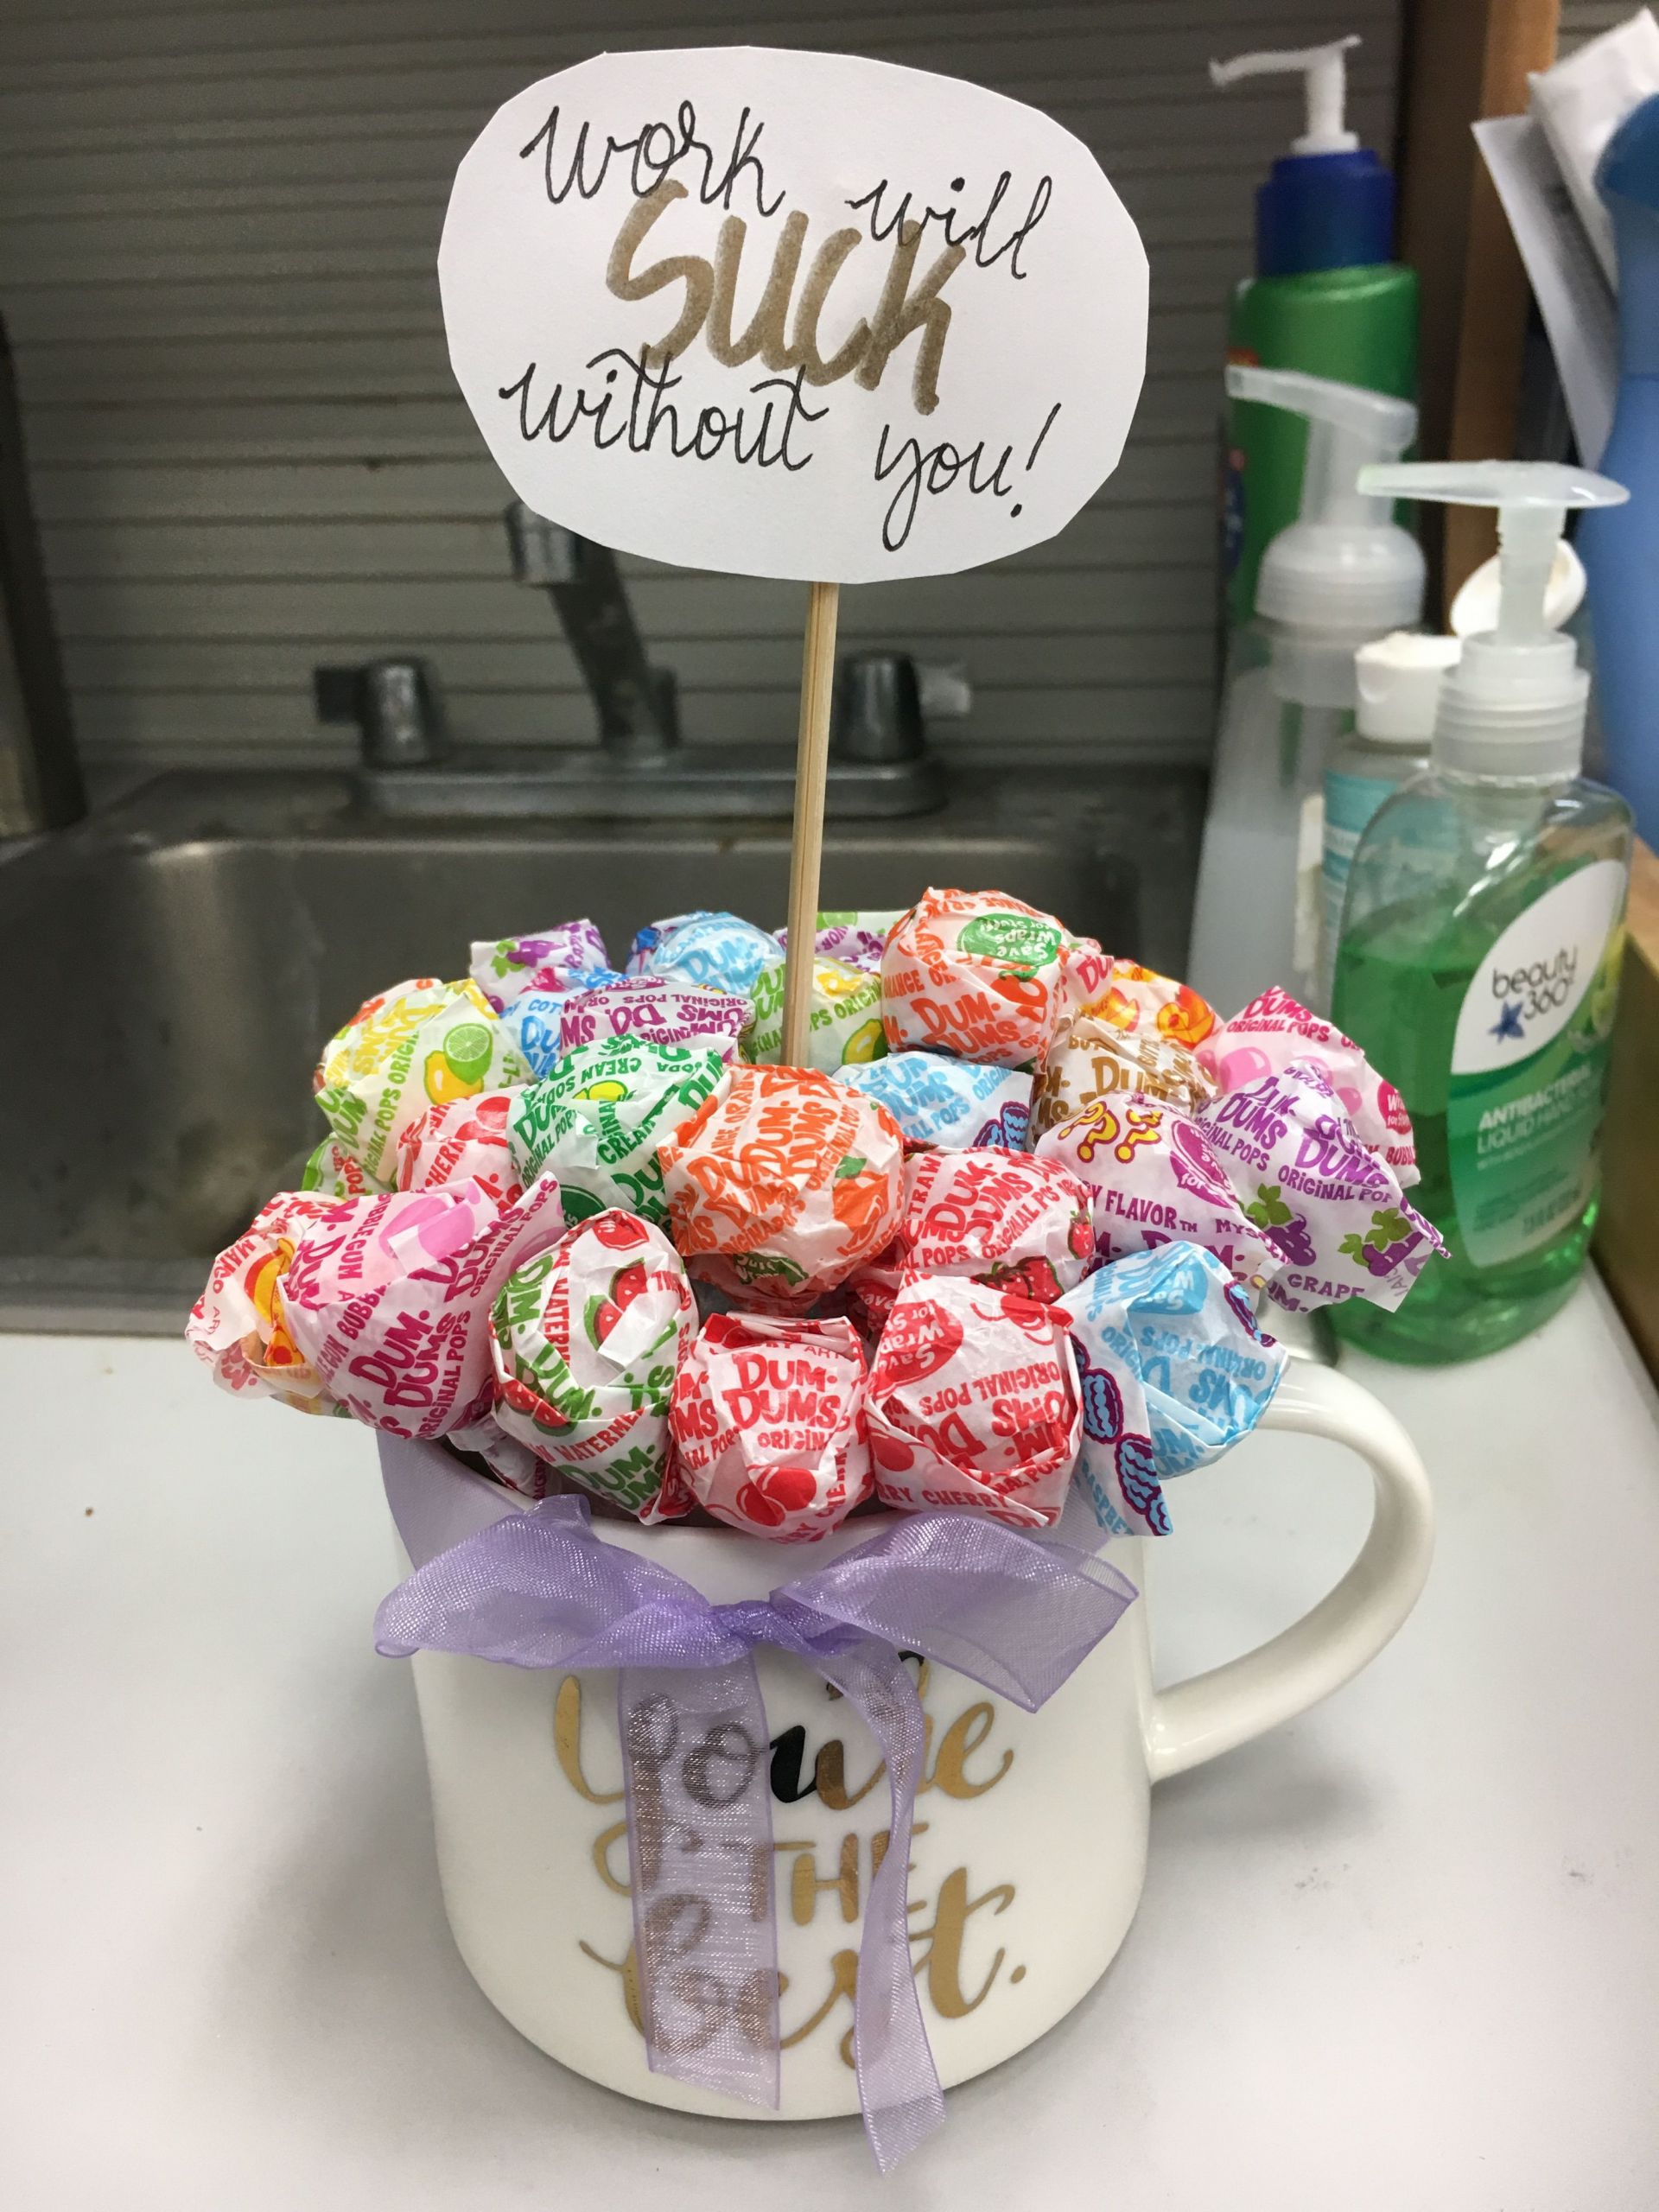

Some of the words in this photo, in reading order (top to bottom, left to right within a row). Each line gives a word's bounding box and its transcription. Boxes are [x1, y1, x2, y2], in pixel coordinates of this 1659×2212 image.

[606, 179, 966, 415] SUCK
[499, 345, 828, 471] without
[874, 403, 1061, 551] you!
[996, 943, 1049, 961] Save
[1491, 944, 1578, 1000] beauty
[623, 993, 668, 1004] POPS
[671, 994, 748, 1007] ORIGINAL
[1225, 1020, 1286, 1034] ORIGINAL
[1287, 1021, 1331, 1043] POPS
[580, 1057, 642, 1084] CREAM
[374, 1087, 401, 1134] POPS
[1217, 1091, 1288, 1152] DUMS
[1233, 1139, 1271, 1172] POPS
[1477, 1115, 1535, 1154] LIQUID
[1294, 1127, 1390, 1189] DUMS
[1278, 1164, 1357, 1203] ORIGINAL
[469, 1225, 521, 1298] ORIGINAL
[524, 1178, 558, 1226] POPS
[982, 1203, 1040, 1259] ORIGINAL
[922, 1244, 972, 1268] POPS
[383, 1311, 457, 1408] DUMS
[418, 1362, 462, 1440] ORIGINAL
[448, 1309, 471, 1362] POPS
[1196, 1342, 1268, 1381] ORIGINAL
[918, 1382, 972, 1416] POPS
[973, 1360, 1061, 1402] ORIGINAL
[721, 1389, 842, 1433] DUMS
[921, 1489, 1010, 1509] CHERRY
[728, 1821, 930, 1926] THE
